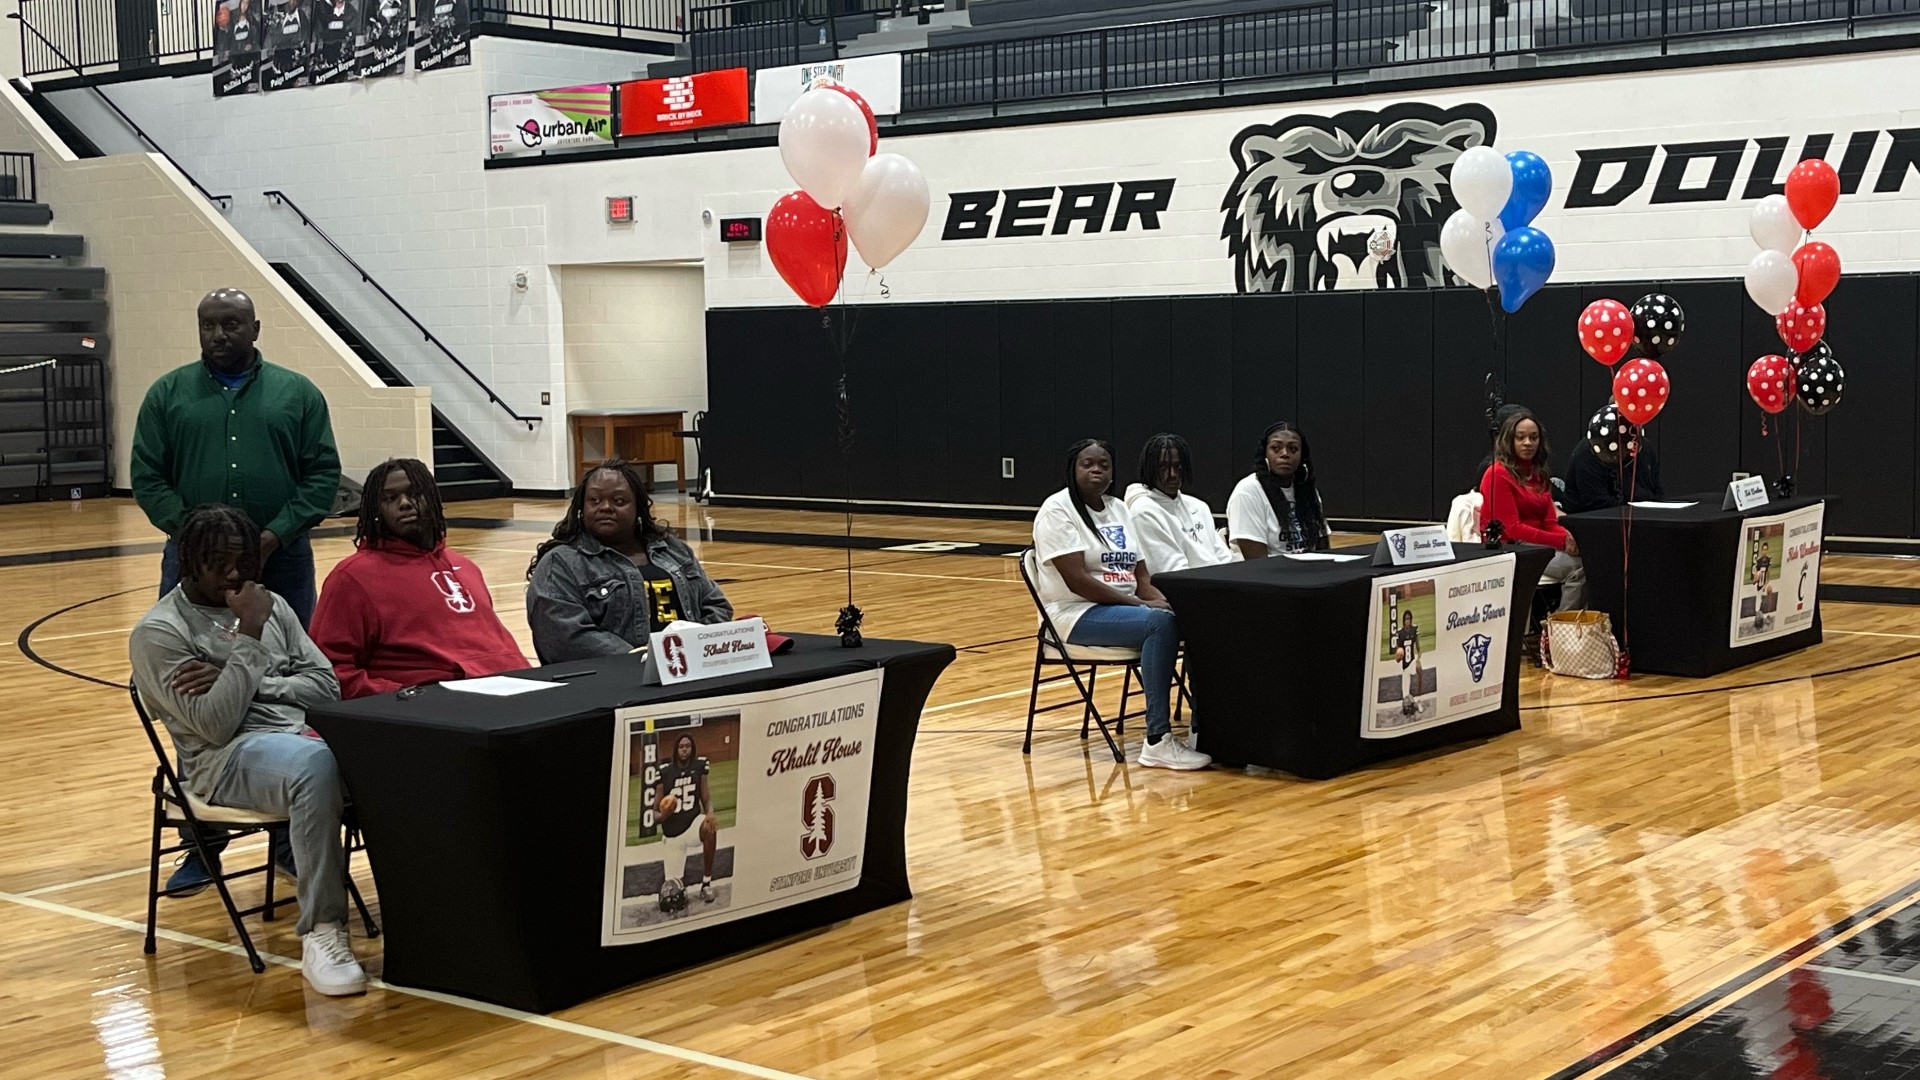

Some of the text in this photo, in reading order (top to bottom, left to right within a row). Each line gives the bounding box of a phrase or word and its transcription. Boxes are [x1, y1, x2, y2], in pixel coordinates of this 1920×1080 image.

[813, 65, 827, 79] STEP
[941, 178, 1177, 240] BEAR
[1448, 577, 1505, 599] CONGRATULATIONS
[698, 626, 755, 640] CONGRATULATIONS
[703, 639, 755, 657] Khalil House
[766, 703, 865, 737] CONGRATULATIONS
[766, 736, 862, 776] Khalil House
[643, 743, 657, 828] HOCO
[769, 868, 813, 892] STANFORD
